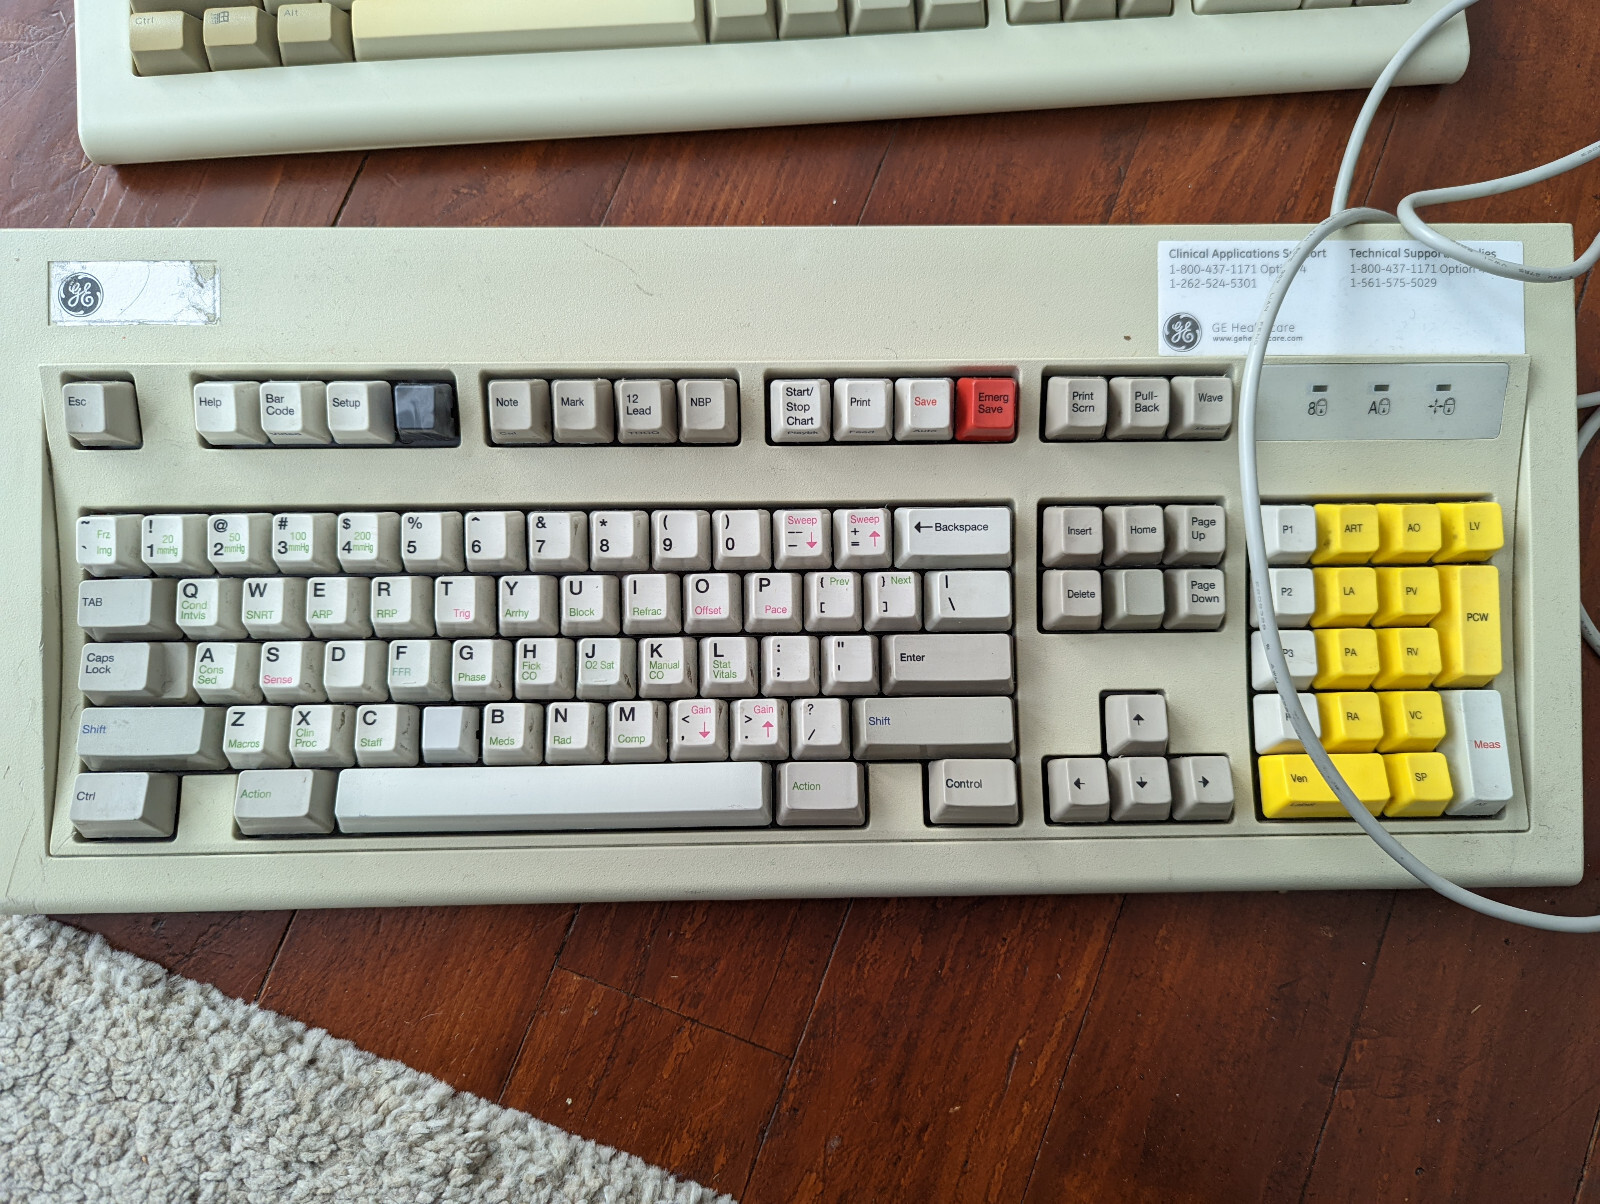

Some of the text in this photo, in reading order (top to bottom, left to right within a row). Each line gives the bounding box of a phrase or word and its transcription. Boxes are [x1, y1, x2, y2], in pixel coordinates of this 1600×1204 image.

[284, 9, 298, 17] Alt
[135, 16, 154, 25] Ctrl
[1169, 249, 1208, 258] Clinical
[1212, 249, 1279, 261] Applications
[1282, 249, 1327, 259] Sort
[1350, 249, 1400, 258] Technical
[1170, 264, 1257, 274] 1-800-437-1171
[1350, 264, 1437, 274] 1-800-437-1171
[1170, 279, 1257, 288] 1-262-524-5301
[1350, 278, 1437, 288] 1-561-575-5029
[1212, 323, 1227, 332] GE
[786, 387, 813, 397] Start/
[1072, 392, 1093, 400] Print
[1135, 392, 1158, 400] Pull-
[68, 397, 87, 406] Esc
[266, 394, 284, 404] Bar
[627, 395, 638, 404] 12
[850, 397, 871, 407] Print
[915, 397, 937, 406] Save
[978, 393, 1009, 403] Emerg
[1198, 393, 1223, 402] Wave
[200, 397, 222, 408] Help
[332, 398, 360, 409] Setup
[496, 398, 518, 407] Note
[561, 398, 584, 407] Mark
[690, 398, 712, 407] NBP
[266, 406, 295, 416] Code
[627, 406, 651, 416] Lead
[786, 402, 810, 414] Stop
[978, 405, 1003, 414] Save
[1072, 403, 1095, 412] Scrn
[1134, 403, 1159, 412] Back
[787, 417, 814, 426] Chart
[788, 516, 817, 526] Sweep
[850, 515, 880, 525] Sweep
[1191, 517, 1216, 527] Page
[934, 523, 989, 532] Backspace
[1068, 526, 1092, 535] Insert
[1130, 525, 1156, 534] Home
[1283, 525, 1293, 534] P1
[1344, 524, 1363, 533] ART
[1407, 523, 1420, 533] AO
[1469, 522, 1480, 531] LV
[97, 530, 111, 539] Frz
[162, 535, 174, 543] 20
[229, 533, 240, 542] 50
[290, 532, 306, 540] 100
[354, 532, 371, 540] 200
[1192, 531, 1206, 541] Up
[277, 541, 288, 554] 3
[342, 541, 352, 553] 4
[353, 543, 373, 553] mmHg
[407, 541, 417, 554] 5
[472, 540, 481, 553] 6
[536, 540, 546, 553] 7
[600, 539, 610, 552] 8
[663, 538, 672, 551] 9
[725, 538, 735, 550] 0
[97, 546, 112, 556] Img
[147, 544, 154, 557] 1
[156, 546, 178, 556] mmHg
[214, 543, 224, 556] 2
[225, 544, 245, 554] mmHg
[288, 544, 309, 554] mmHg
[830, 577, 849, 585] Prev
[891, 576, 911, 584] Next
[378, 582, 391, 596] R
[441, 582, 453, 595] T
[505, 582, 518, 595] Y
[570, 581, 583, 595] U
[695, 579, 709, 593] O
[759, 578, 771, 592] P
[1191, 581, 1215, 591] Page
[183, 583, 198, 598] Q
[249, 583, 267, 597] W
[314, 583, 326, 597] E
[1068, 590, 1095, 598] Delete
[1281, 588, 1292, 596] P2
[1344, 587, 1355, 596] LA
[1406, 587, 1417, 596] PV
[82, 598, 103, 607] TAB
[1191, 594, 1219, 603] Down
[182, 601, 207, 610] Cond
[765, 605, 787, 614] Pace
[312, 610, 333, 619] ARP
[377, 610, 397, 618] RRP
[454, 609, 470, 619] Trig
[505, 609, 529, 619] Arrhy
[570, 608, 595, 617] Block
[633, 607, 662, 616] Refrac
[695, 606, 721, 615] Offset
[246, 611, 274, 620] SNRT
[1467, 613, 1488, 622] PCW
[266, 647, 279, 662] S
[332, 647, 345, 661] D
[396, 646, 408, 660] F
[459, 645, 474, 660] G
[523, 644, 536, 658] H
[585, 644, 596, 658] J
[650, 644, 663, 658] K
[714, 643, 724, 657] L
[1283, 649, 1294, 658] P3
[1345, 648, 1357, 657] PA
[1406, 648, 1418, 656] RV
[87, 653, 114, 664] Caps
[200, 648, 214, 662] A
[900, 653, 925, 662] Enter
[522, 662, 541, 670] Fick
[600, 661, 614, 669] Sat
[649, 660, 680, 669] Manual
[713, 660, 731, 669] Stat
[85, 665, 111, 674] Lock
[199, 665, 224, 675] Cons
[392, 668, 411, 676] FFR
[458, 673, 486, 682] Phase
[522, 671, 537, 680] CO
[649, 671, 664, 679] CO
[713, 670, 737, 679] Vitals
[198, 676, 217, 685] Sed
[264, 676, 292, 684] Sense
[619, 707, 635, 721] M
[691, 706, 711, 714] Gain
[754, 705, 773, 714] Gain
[231, 712, 246, 727] Z
[297, 711, 311, 726] X
[362, 710, 377, 726] C
[492, 709, 504, 723] B
[555, 708, 568, 722] N
[1346, 712, 1360, 721] RA
[1409, 711, 1422, 719] VC
[868, 716, 891, 725] Shift
[82, 724, 106, 734] Shift
[296, 728, 314, 737] Clin
[228, 739, 260, 748] Macros
[295, 739, 317, 747] Proc
[360, 738, 383, 747] Staff
[489, 737, 515, 746] Meds
[553, 736, 572, 744] Rad
[618, 735, 645, 745] Comp
[1474, 740, 1501, 749] Meas
[1291, 774, 1308, 783] Ven
[1415, 773, 1427, 782] SP
[792, 781, 821, 791] Action
[945, 779, 983, 789] Control
[77, 792, 95, 801] Ctrl
[240, 789, 272, 799] Action
